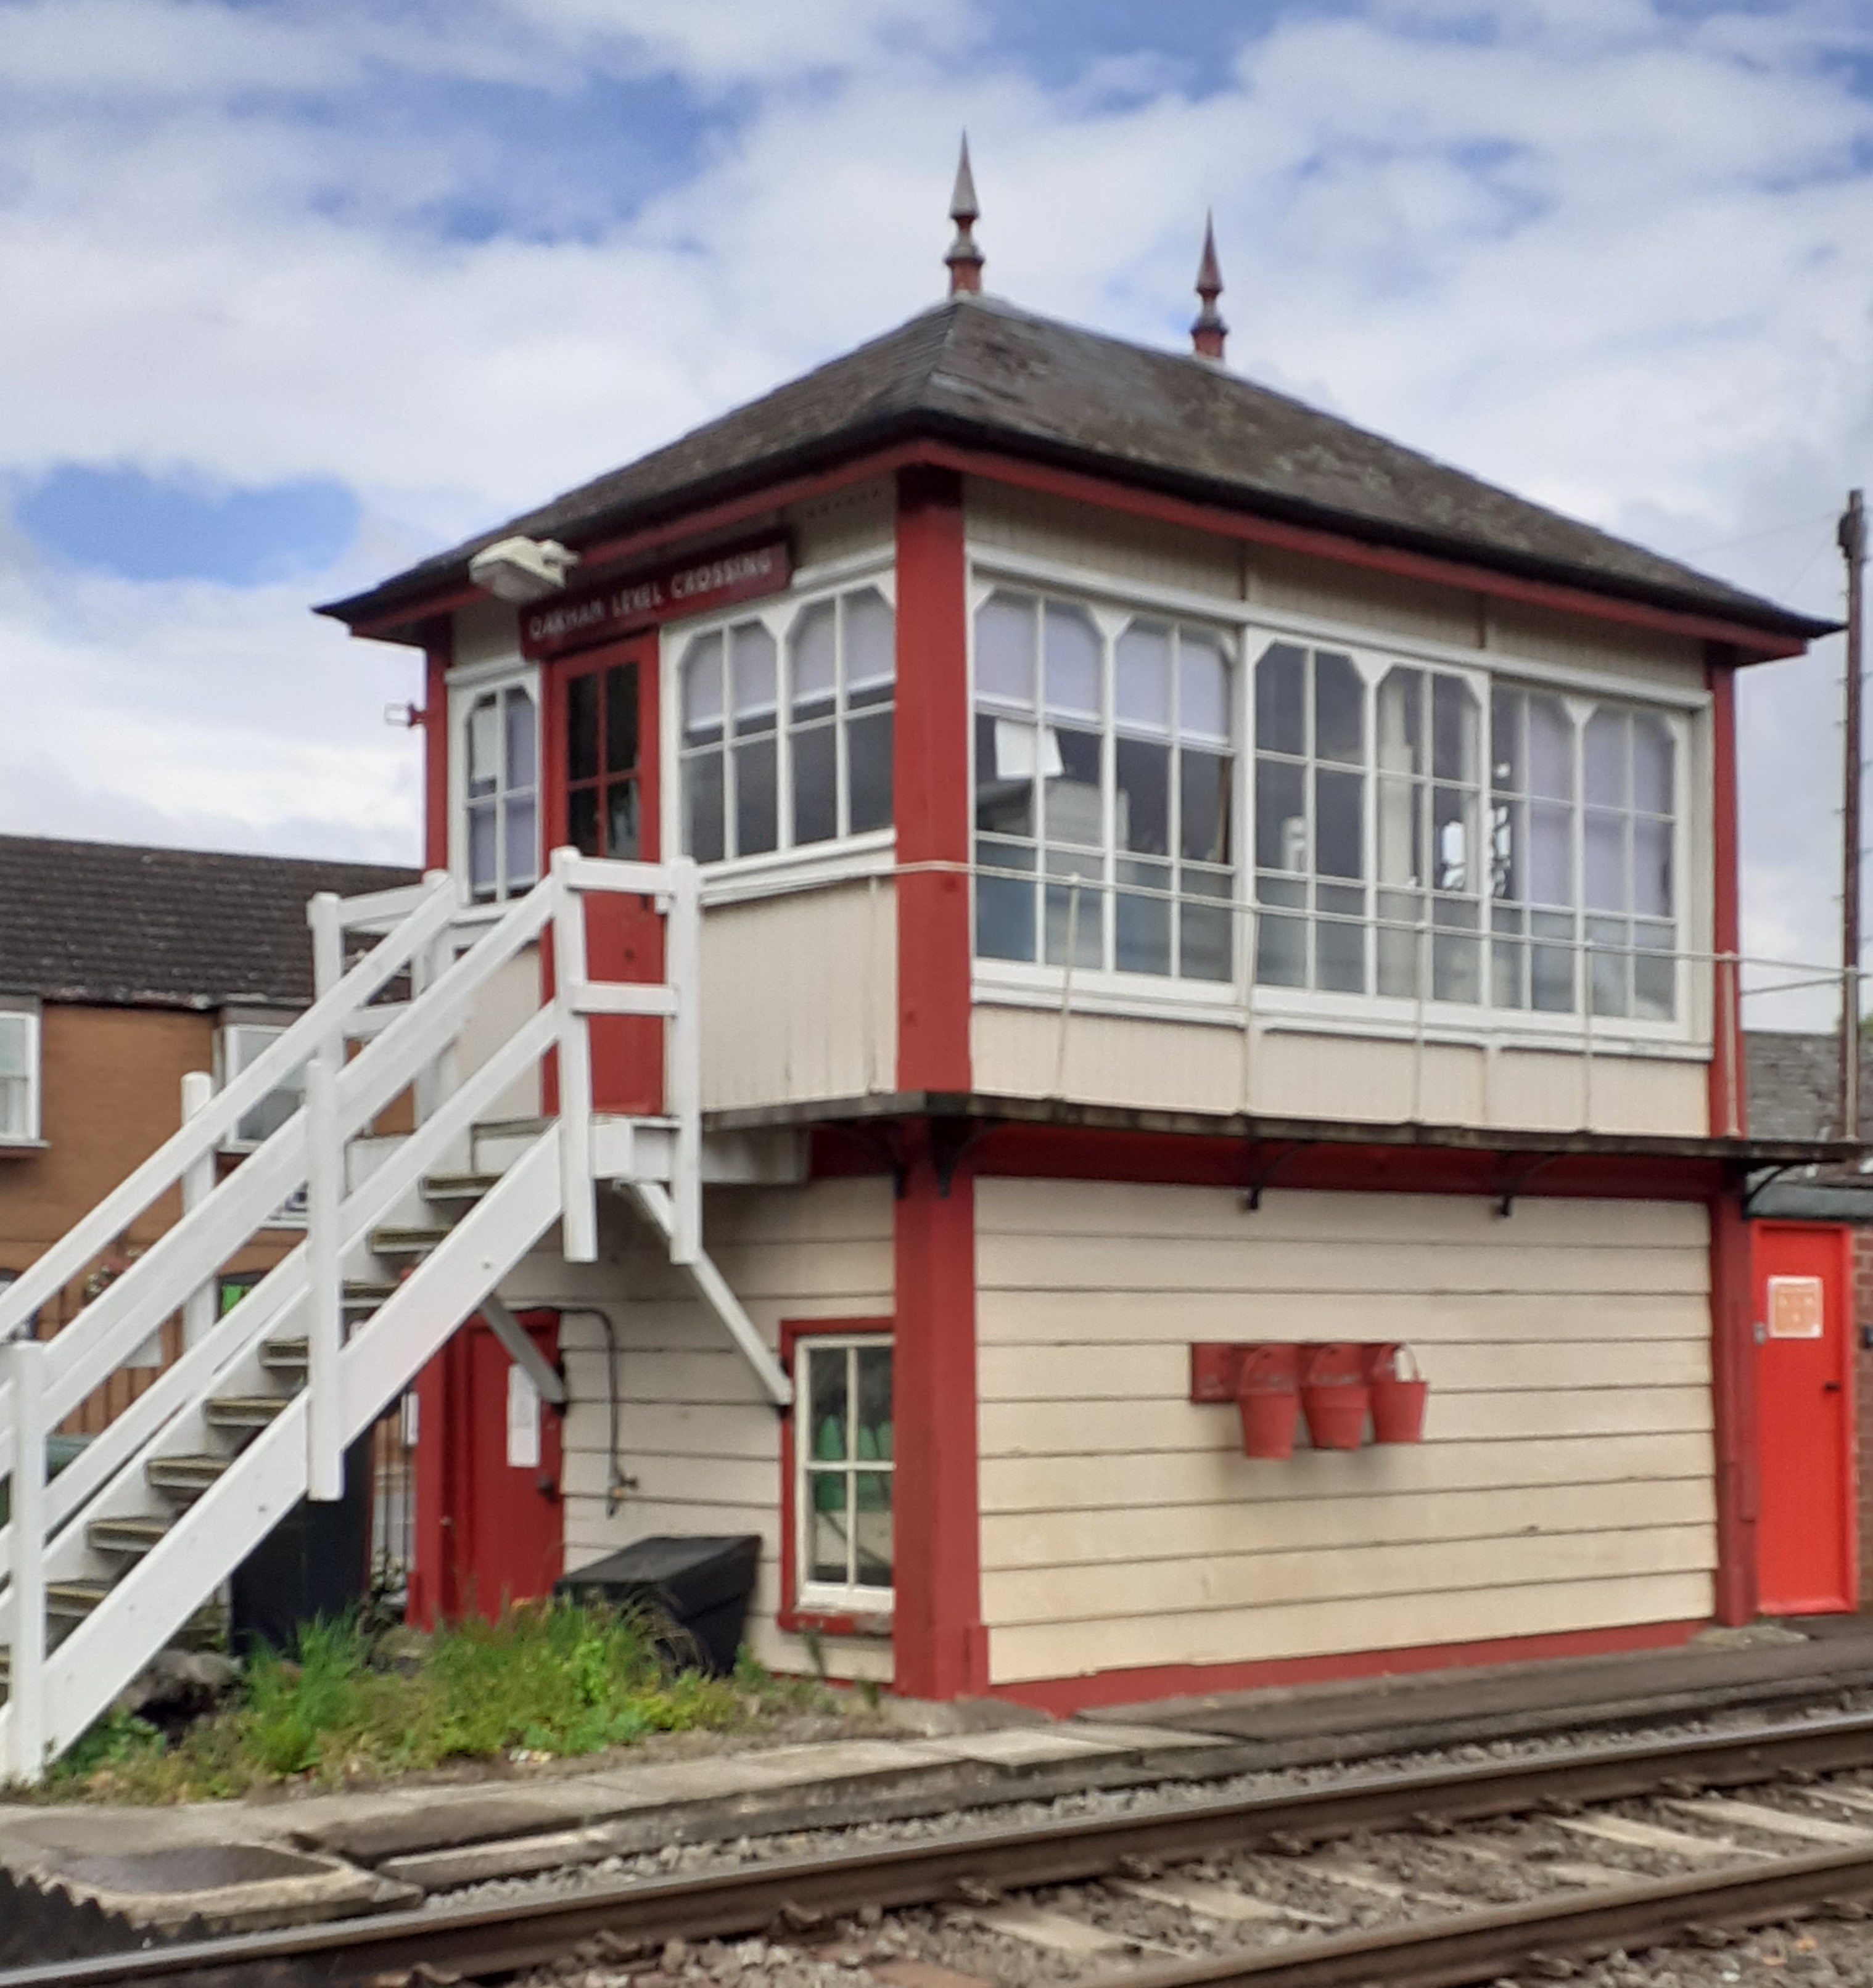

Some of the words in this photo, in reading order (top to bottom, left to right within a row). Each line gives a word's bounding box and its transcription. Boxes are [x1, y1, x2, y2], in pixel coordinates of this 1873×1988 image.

[529, 600, 605, 640] OAKHAM
[612, 582, 661, 617] LEVEL
[671, 548, 772, 599] CROSSING
